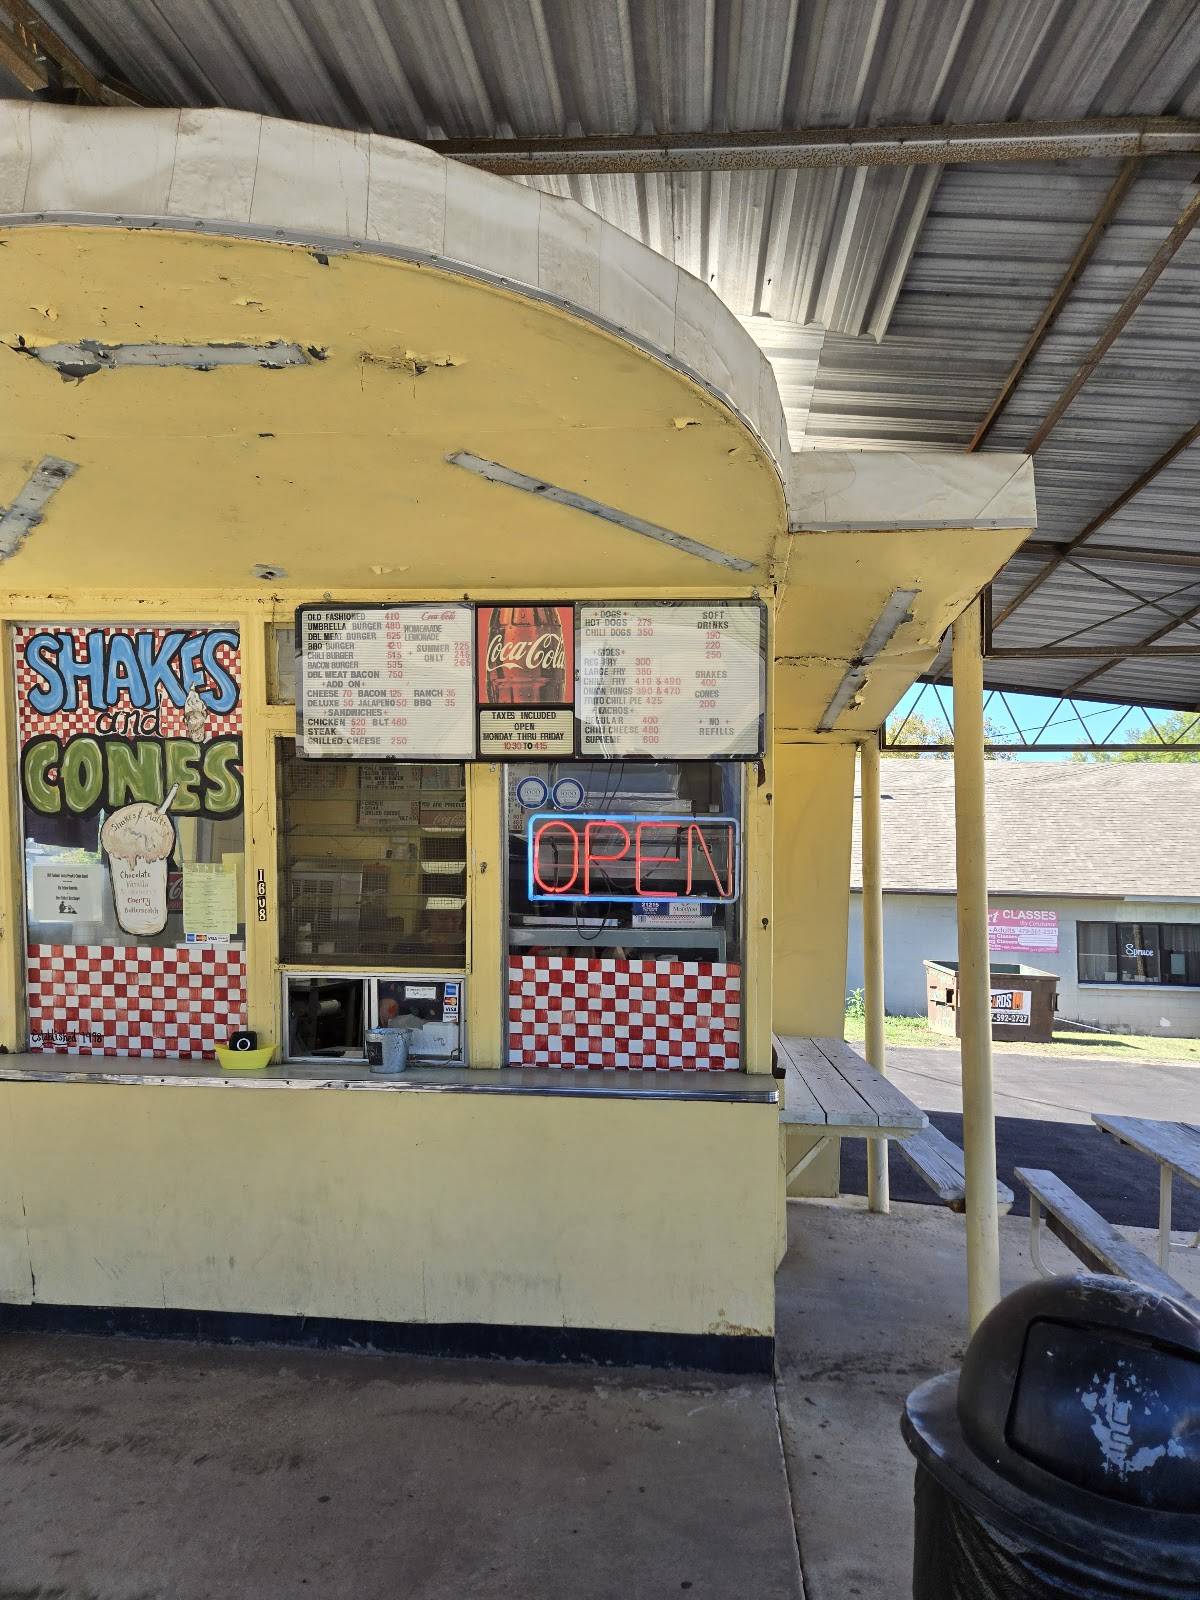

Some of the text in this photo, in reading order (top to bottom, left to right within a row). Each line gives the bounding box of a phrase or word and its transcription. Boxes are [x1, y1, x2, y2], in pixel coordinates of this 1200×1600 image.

[307, 613, 322, 621] OLD
[325, 612, 366, 621] FASHIONED
[600, 610, 621, 619] DOGS
[702, 611, 725, 620] SOFT
[307, 622, 347, 631] UMBRELLA
[352, 622, 382, 630] BURGER
[585, 618, 601, 627] HOT
[604, 618, 628, 627] DOGS
[697, 621, 729, 630] DRINKS
[404, 624, 443, 633] HOMEMADE
[585, 628, 606, 637] CHILI
[610, 628, 632, 637] DOGS
[308, 632, 323, 641] DBL
[323, 632, 344, 640] MEAT
[346, 632, 377, 640] BURGER
[307, 642, 323, 651] BBQ
[325, 641, 355, 650] BURGER
[416, 643, 450, 653] SUMMER
[307, 651, 325, 660] CHILI
[326, 651, 354, 660] BURGER
[486, 633, 566, 672] Coca-Cola
[598, 648, 621, 657] SIDES
[424, 653, 445, 662] ONLY
[307, 661, 330, 670] BACON
[331, 660, 359, 669] BURGER
[24, 630, 240, 716] SHAKES
[307, 670, 403, 679] DBL MEAT BACON 750
[583, 667, 609, 676] LARGE
[612, 667, 627, 676] FRY
[695, 670, 728, 679] SHAKES
[326, 680, 361, 688] ADD ON
[612, 677, 626, 686] FRY
[307, 689, 339, 698] CHEESE
[357, 689, 387, 698] BACON
[413, 689, 443, 698] RANCH
[694, 689, 720, 699] CONES
[307, 699, 340, 707] DELUXE
[413, 699, 432, 707] BBQ
[606, 696, 626, 705] CHILI
[629, 696, 642, 705] PIE
[327, 708, 383, 717] SANDWICHES
[491, 711, 557, 720] TAXES INCLUDED
[96, 702, 162, 736] and
[307, 718, 346, 727] CHICKEN
[372, 718, 389, 726] BLT
[708, 717, 720, 726] NO
[513, 722, 535, 731] OPEN
[584, 726, 606, 735] CHILI
[608, 726, 639, 735] CHEESE
[307, 727, 337, 736] STEAK
[698, 728, 735, 736] REFILLS
[307, 736, 408, 745] GRILLED CHEESE 250
[482, 732, 564, 741] MONDAY THRU FRIDAY
[585, 735, 622, 744] SUPREME
[523, 742, 533, 750] TO
[22, 733, 243, 819] CONES
[111, 813, 136, 832] Shakes
[145, 811, 167, 827] Malts
[534, 820, 734, 896] OPEN
[119, 869, 152, 880] Chocolate
[257, 868, 267, 922] 1608
[127, 897, 151, 907] Cherry
[124, 906, 160, 915] Butterscotch
[1002, 909, 1057, 921] CLASSES
[1125, 943, 1154, 957] Spruce
[990, 993, 1012, 1008] ARDS
[991, 1013, 1028, 1022] 7-592-2737
[31, 1028, 103, 1046] Established 1998
